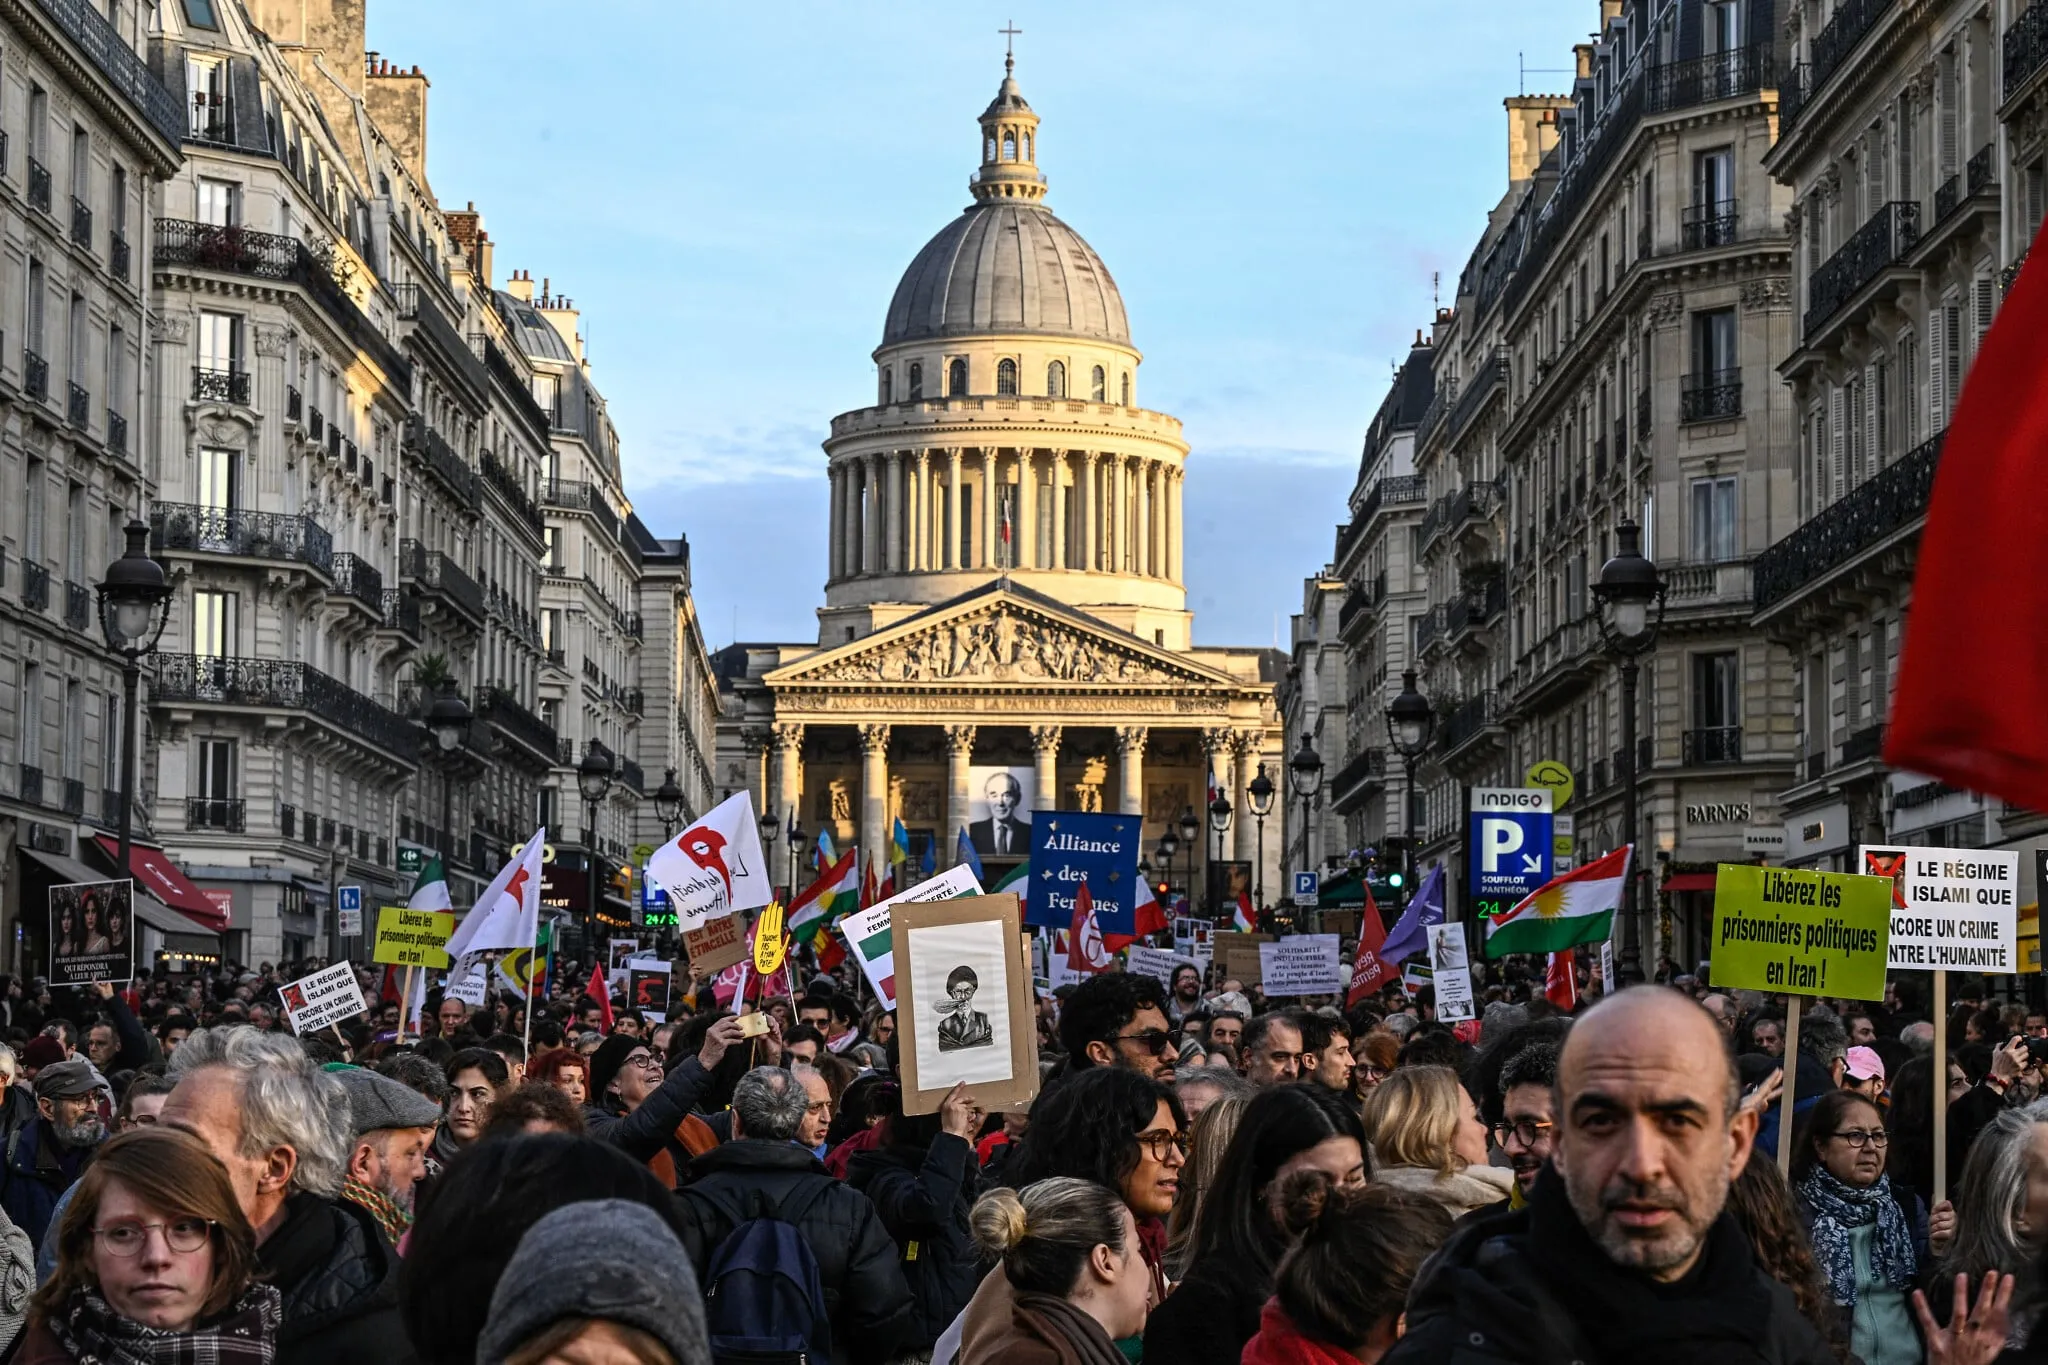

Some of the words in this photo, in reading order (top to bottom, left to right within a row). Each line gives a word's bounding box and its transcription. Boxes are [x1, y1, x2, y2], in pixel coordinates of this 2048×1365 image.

[862, 697, 916, 710] GRANDS
[1004, 698, 1050, 712] PATRIE
[1482, 794, 1542, 808] INDIGO
[1686, 802, 1751, 823] BARNES
[1044, 834, 1120, 853] Alliance
[1482, 818, 1524, 872] P
[1747, 836, 1783, 844] SANDRO
[1058, 864, 1088, 882] des
[1482, 876, 1526, 884] SOUFFLOT
[1918, 861, 1938, 877] LE
[1944, 859, 2008, 880] RÉGIME
[1482, 884, 1530, 894] PANTHÉON
[1763, 871, 1816, 906] Libérez
[1820, 876, 1841, 908] les
[1912, 886, 1970, 904] ISLAMI
[1976, 888, 2012, 905] QUE
[1048, 892, 1119, 913] Femes
[398, 910, 422, 926] Libérez
[422, 913, 432, 928] les
[866, 918, 891, 934] FEMM
[1889, 918, 1932, 937] NCORE
[1936, 919, 1955, 938] UN
[1959, 920, 1999, 940] CRIME
[380, 929, 416, 946] prisonniers
[416, 934, 446, 950] politiques
[1721, 910, 1802, 946] prisonniers
[1804, 918, 1877, 958] politiques
[398, 950, 407, 962] en
[408, 949, 420, 962] Iran
[1889, 944, 1924, 964] NTRE
[1928, 944, 2007, 967] L'HUMANITÉ
[305, 980, 316, 990] LE
[318, 968, 348, 985] RÉGIME
[1766, 960, 1784, 985] en
[1788, 956, 1817, 988] Iran
[308, 985, 334, 1001] ISLAMI
[336, 976, 354, 989] QUE
[457, 982, 484, 990] NOCIDE
[298, 1004, 324, 1022] ENCORE
[324, 1000, 334, 1010] UN
[334, 992, 354, 1006] CRIME
[298, 1016, 324, 1032] CONTRE
[324, 1000, 362, 1022] L'HUMANITÉ
